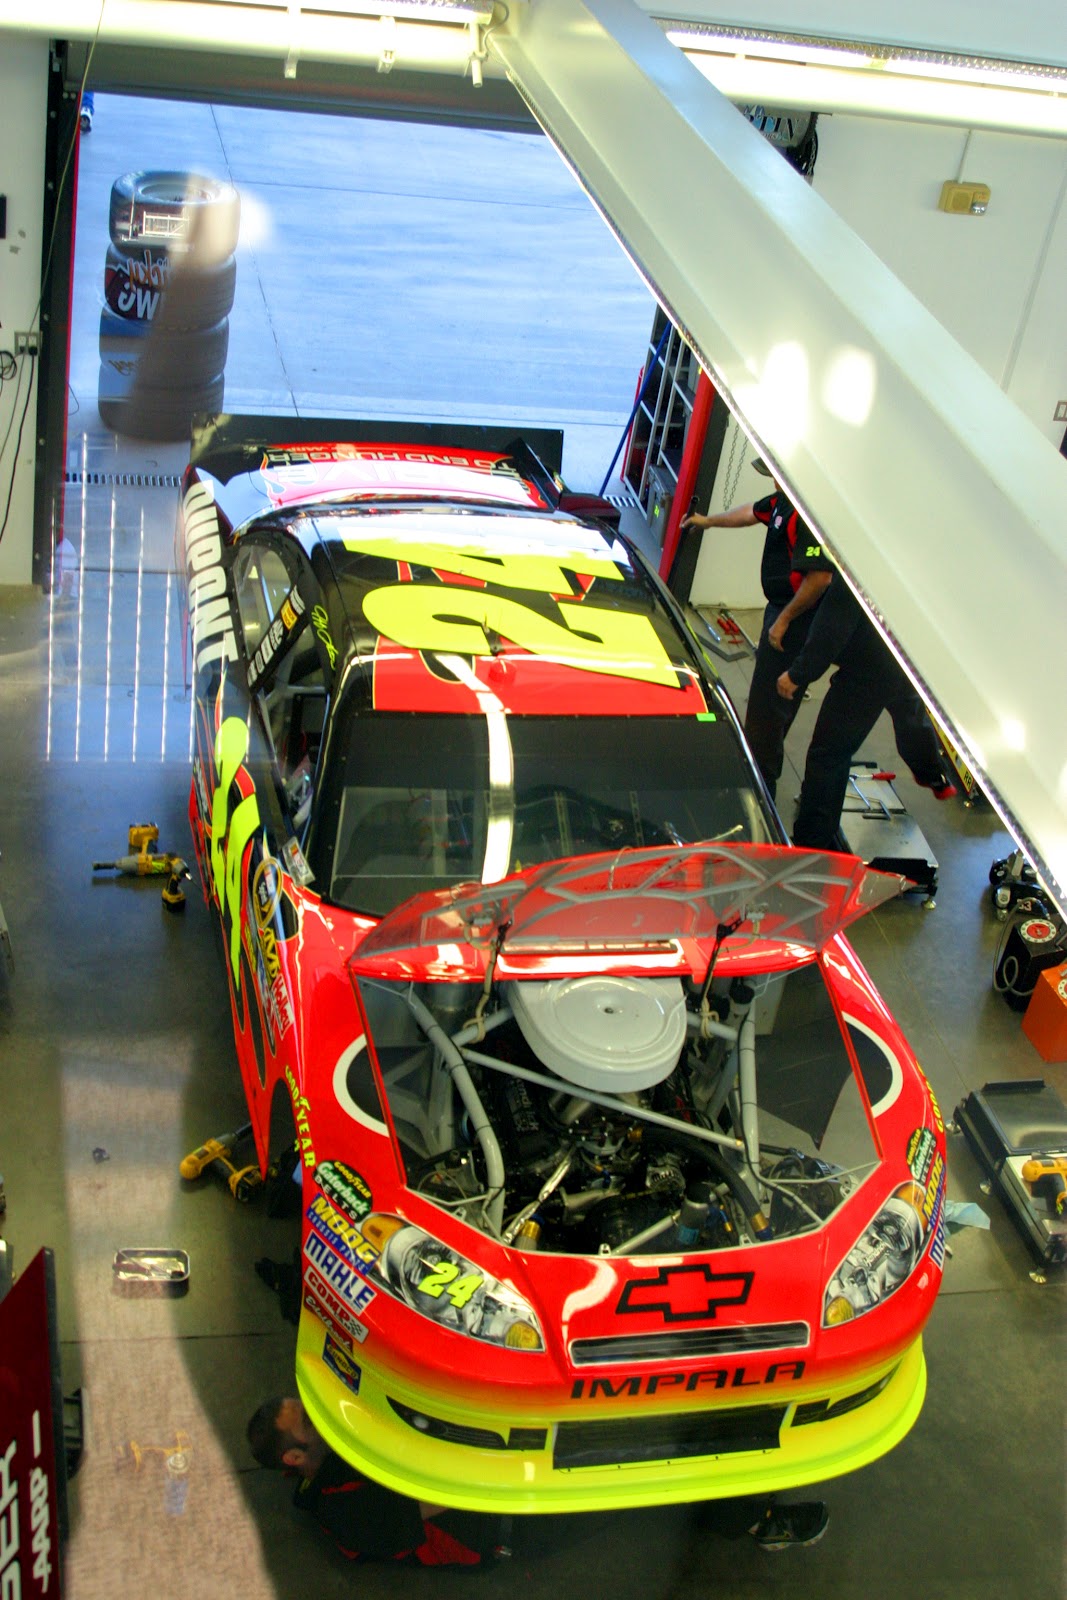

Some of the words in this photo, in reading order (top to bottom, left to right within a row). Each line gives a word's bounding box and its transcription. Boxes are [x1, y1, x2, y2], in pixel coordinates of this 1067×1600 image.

[268, 450, 399, 464] HUNGER
[405, 453, 469, 466] END
[805, 546, 821, 557] 24
[336, 526, 681, 688] 24
[313, 1174, 360, 1222] BELTS
[315, 1161, 370, 1216] Gatorback
[333, 1160, 372, 1199] GOODYEAR
[923, 1155, 944, 1219] MOOG
[309, 1200, 380, 1264] MOOG
[306, 1236, 374, 1311] MAHLE
[417, 1262, 485, 1309] 24
[308, 1273, 350, 1327] COMP
[327, 1342, 359, 1380] SUNOCO
[570, 1361, 806, 1399] IMPALA
[30, 1466, 52, 1594] AARP
